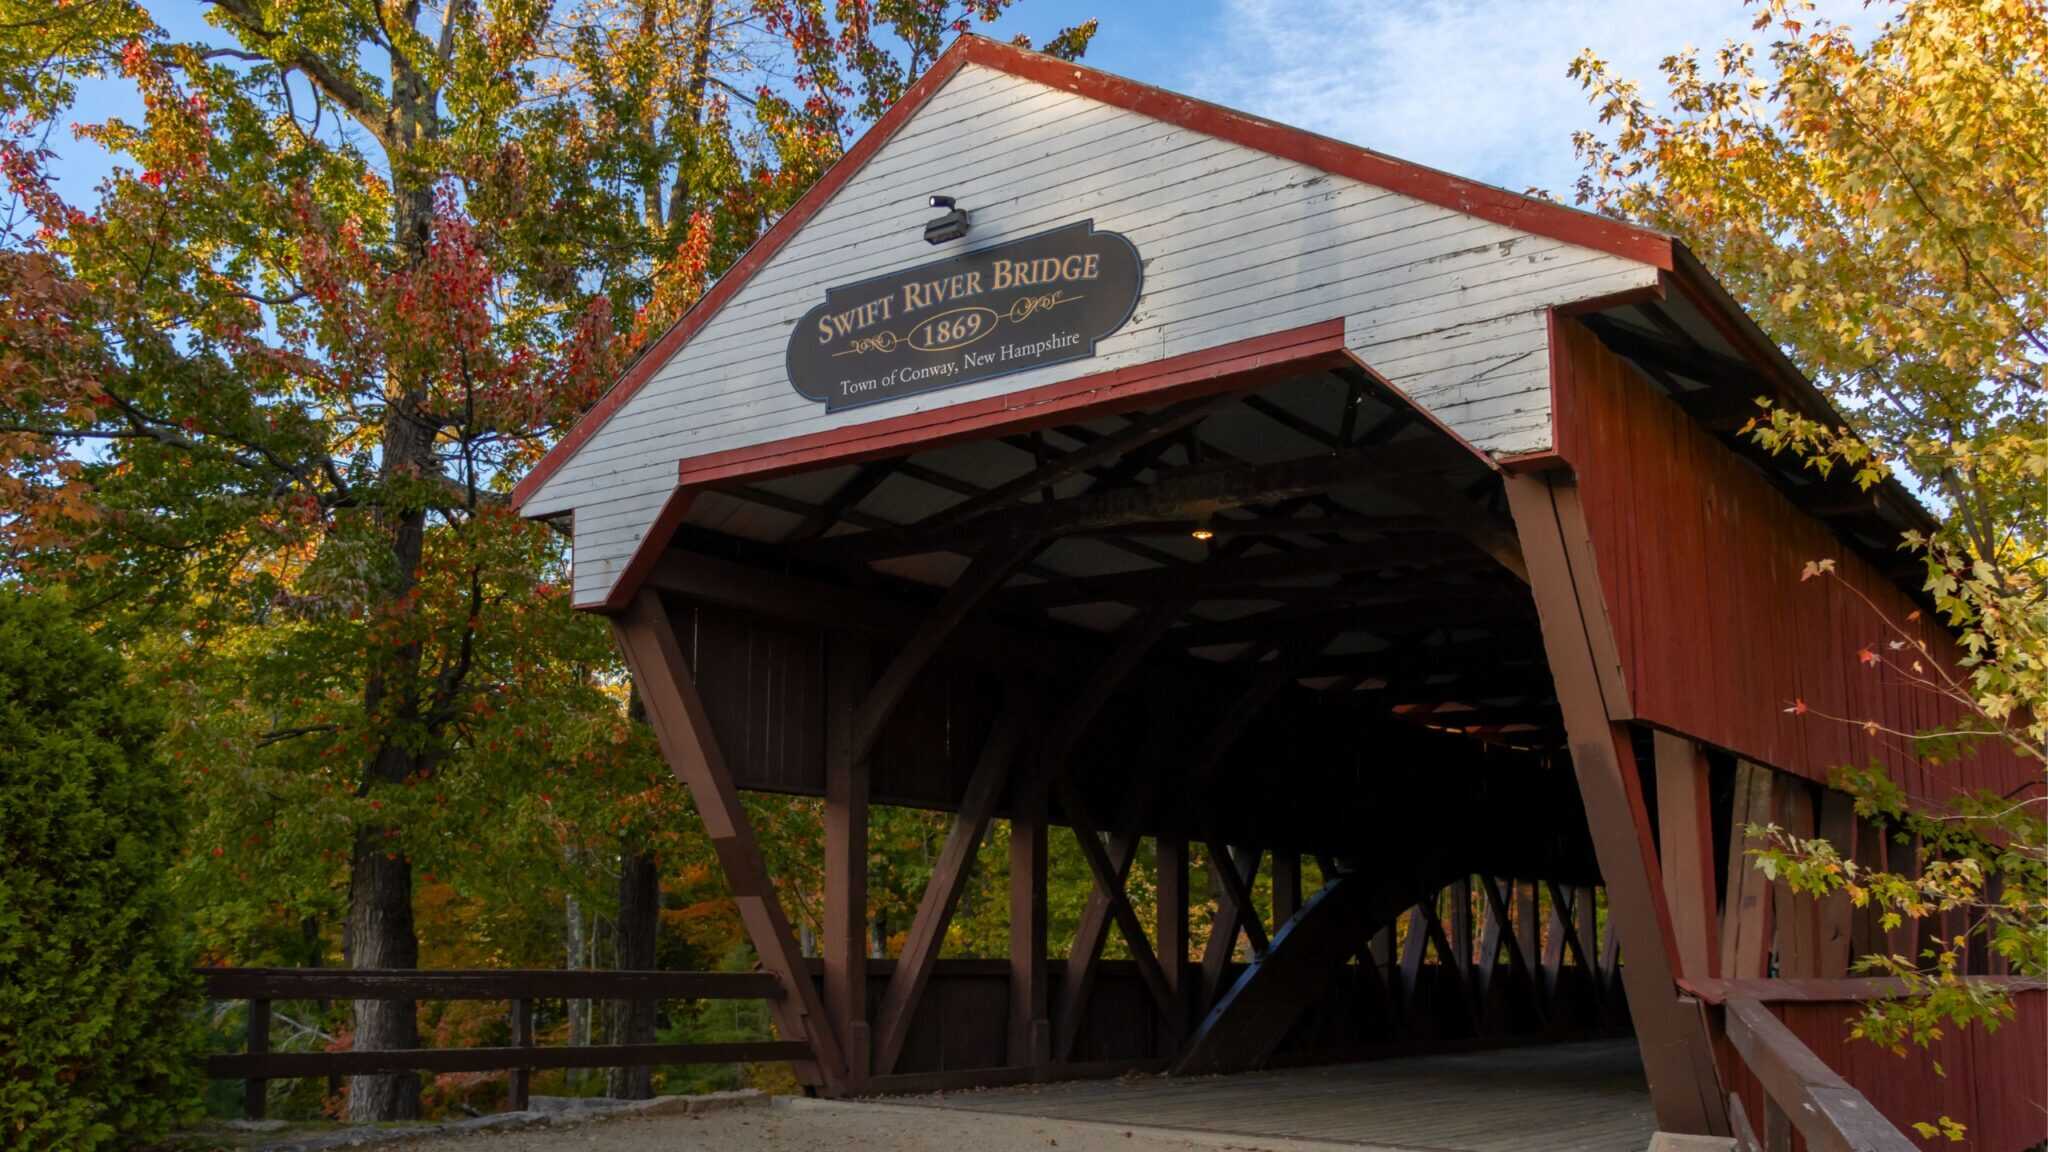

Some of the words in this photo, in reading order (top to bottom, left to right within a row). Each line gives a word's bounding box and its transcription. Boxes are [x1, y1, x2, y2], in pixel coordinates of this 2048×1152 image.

[818, 294, 894, 344] SWIFT
[903, 271, 982, 312] RIVER
[992, 253, 1099, 290] BRIDGE
[922, 313, 981, 346] 1869
[840, 376, 877, 395] Town
[881, 369, 898, 387] of
[900, 361, 959, 383] Conway,
[964, 352, 995, 368] New
[1001, 331, 1080, 361] Hampshire
